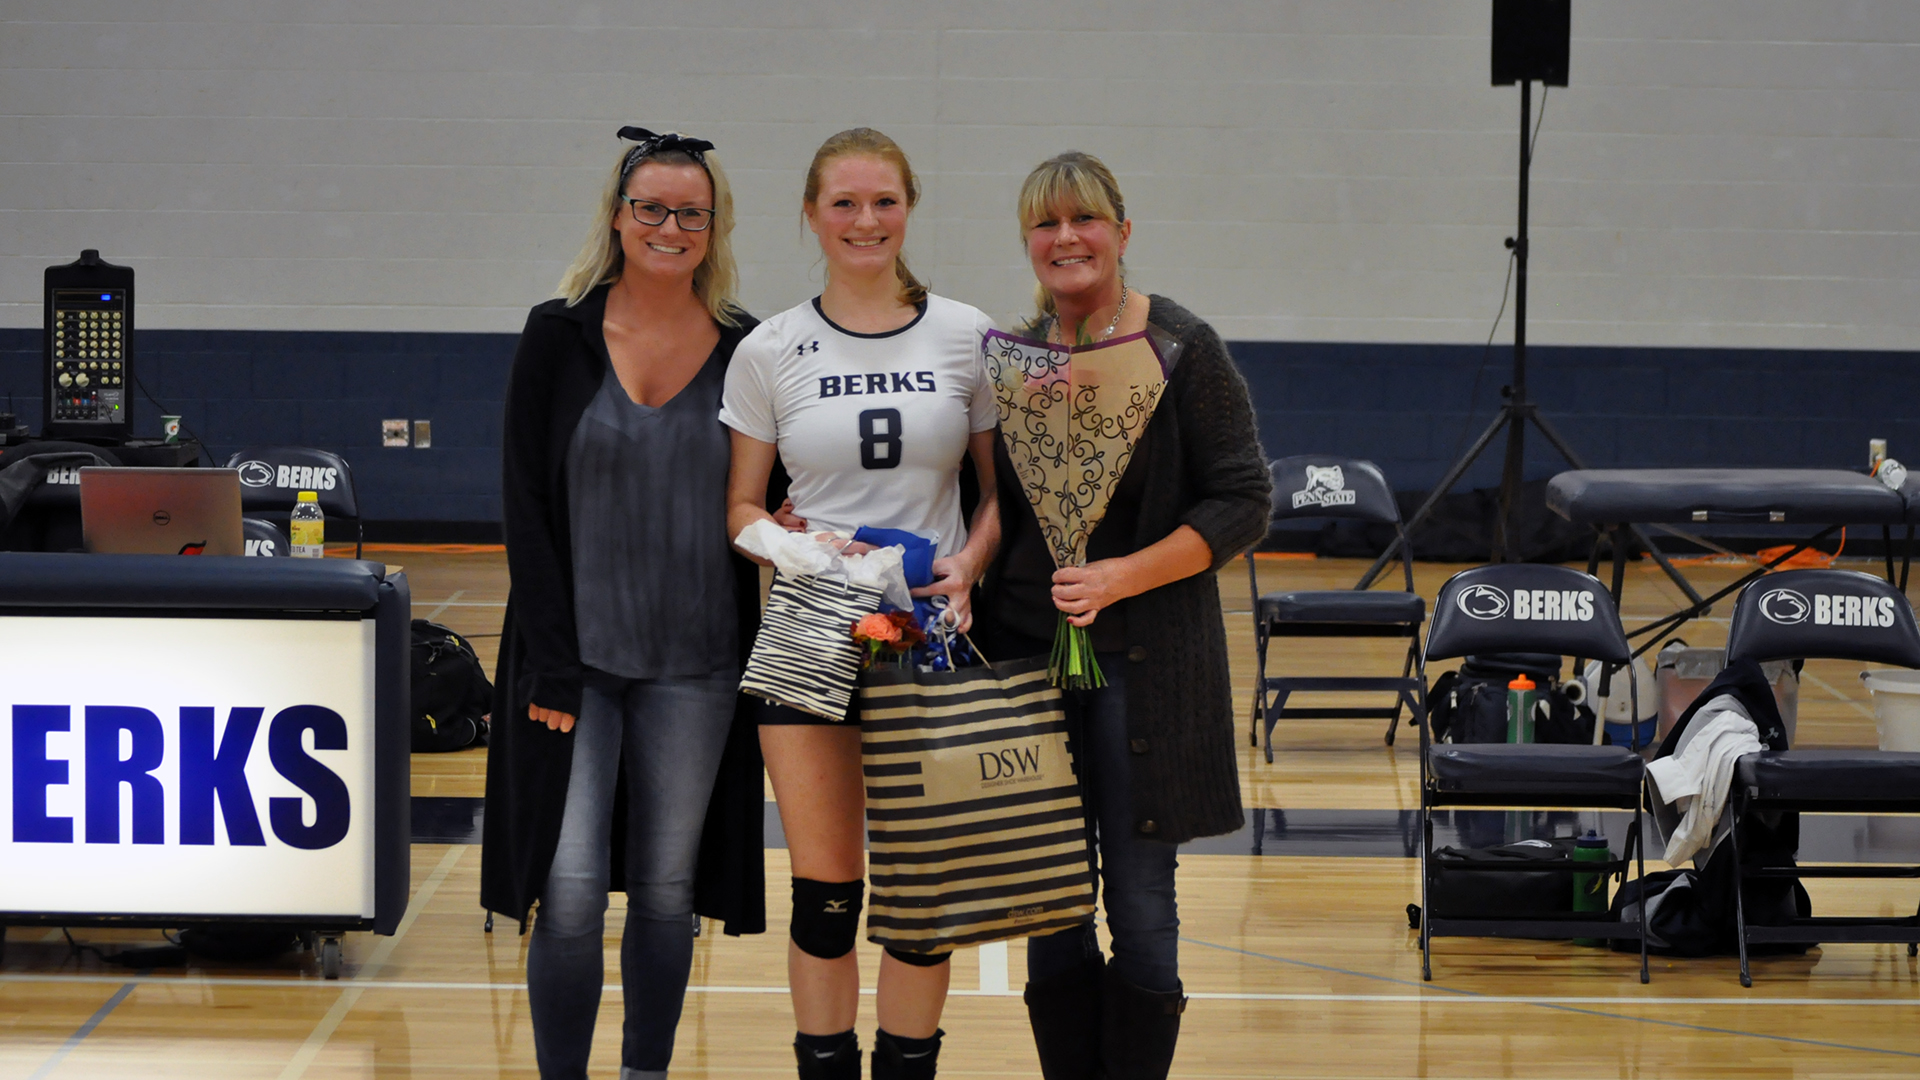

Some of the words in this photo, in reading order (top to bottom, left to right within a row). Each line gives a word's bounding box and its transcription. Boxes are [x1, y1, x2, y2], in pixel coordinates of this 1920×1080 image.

[819, 371, 936, 399] BERKS
[859, 408, 902, 469] 8
[276, 465, 337, 490] BERKS
[1294, 488, 1322, 507] PENN
[1323, 492, 1355, 505] STATE
[296, 546, 306, 554] TEA
[1513, 589, 1594, 621] BERKS
[1814, 594, 1895, 628] BERKS
[12, 704, 351, 850] ERKS
[976, 745, 1040, 781] DSW
